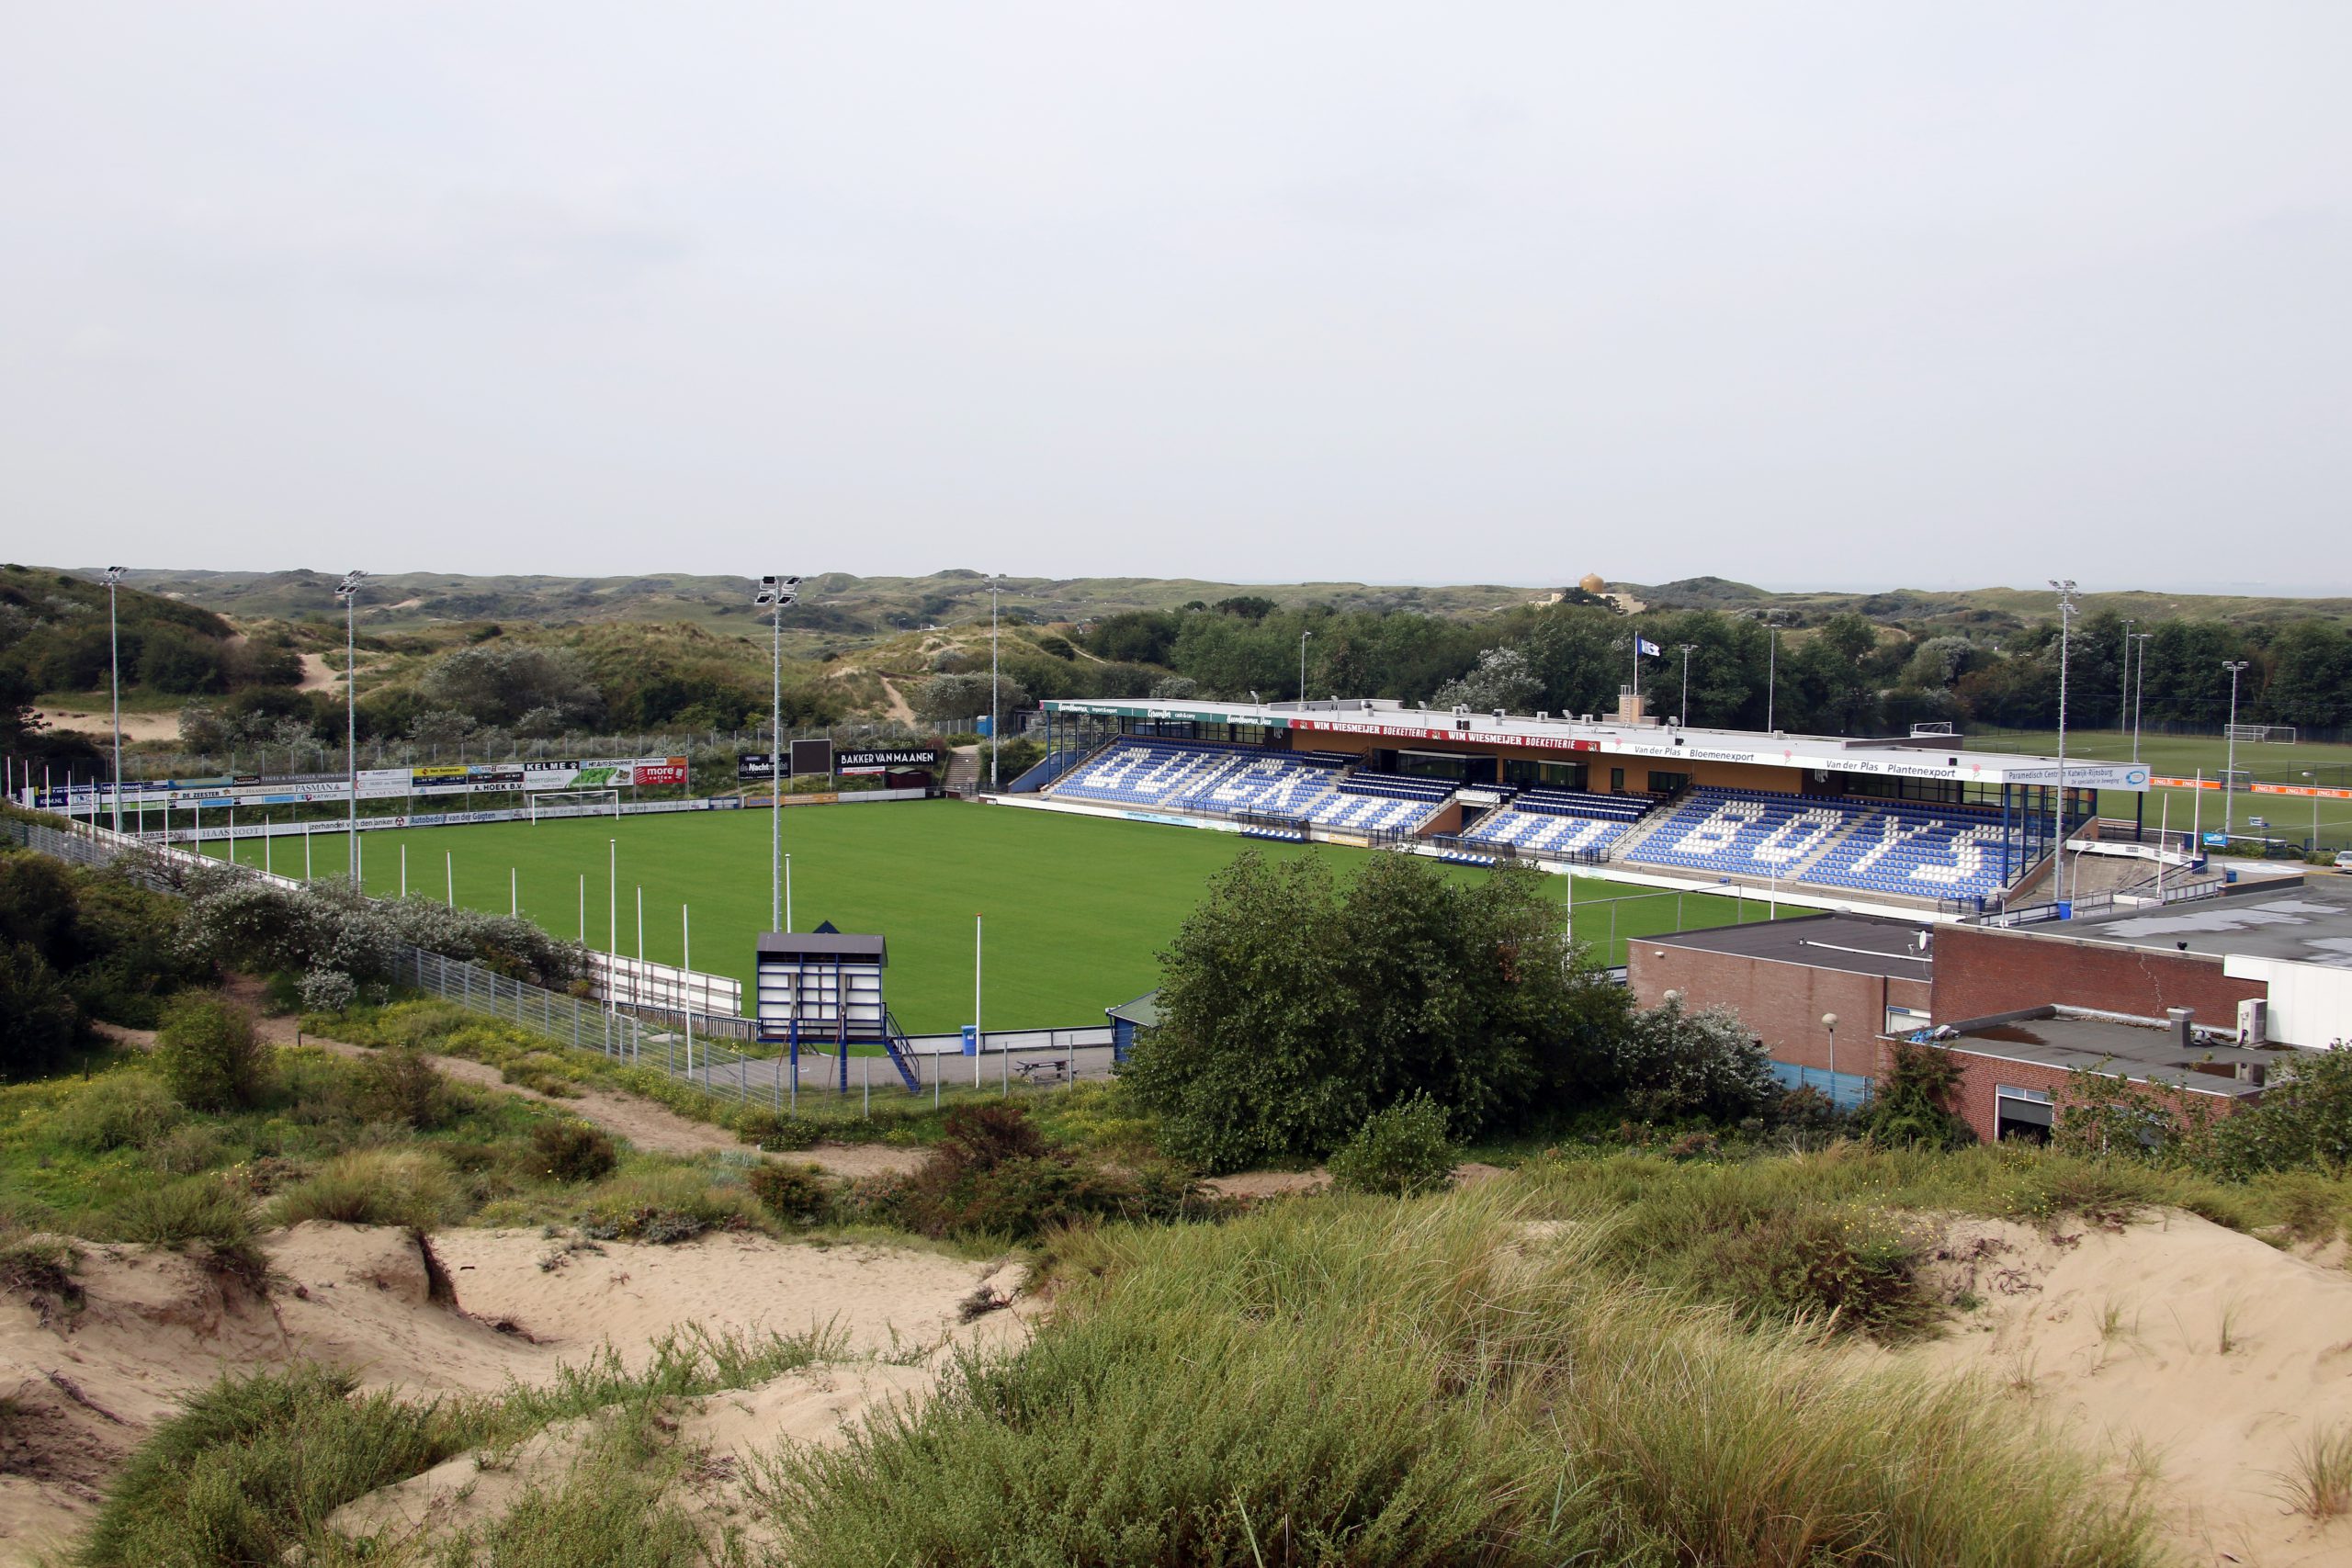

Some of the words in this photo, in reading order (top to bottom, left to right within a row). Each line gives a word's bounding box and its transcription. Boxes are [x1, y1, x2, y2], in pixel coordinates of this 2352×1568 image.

[1314, 721, 1329, 730] WIM
[1332, 722, 1380, 734] WIESMEIJER
[1383, 727, 1428, 738] BOEKETTERIE
[1448, 731, 1466, 740] WIM
[1468, 732, 1522, 745] WIESMEIJER
[1525, 737, 1576, 750] BOEKETTERIE
[841, 754, 874, 764] BAKKER
[875, 753, 893, 762] VAN
[894, 752, 933, 762] MAANEN
[1649, 747, 1663, 755] der
[1664, 747, 1681, 756] Plas
[1690, 749, 1755, 761] Bloemenexport
[526, 762, 566, 771] KELME
[647, 767, 673, 775] more
[1826, 760, 1841, 769] Van
[1843, 761, 1857, 770] der
[1860, 761, 1879, 772] Plas
[1887, 763, 1956, 778] Plantenexport
[2008, 770, 2043, 779] Paramedisch
[2044, 770, 2066, 778] Centrm
[2067, 768, 2113, 778] Katwijk-Rijnsburg
[295, 783, 334, 793] PASMAN
[411, 814, 447, 824] Autobedrijf
[472, 812, 496, 822] Gugten
[308, 821, 345, 831] jzerhandel
[374, 818, 393, 827] anker
[202, 827, 259, 837] HAASNOOT
